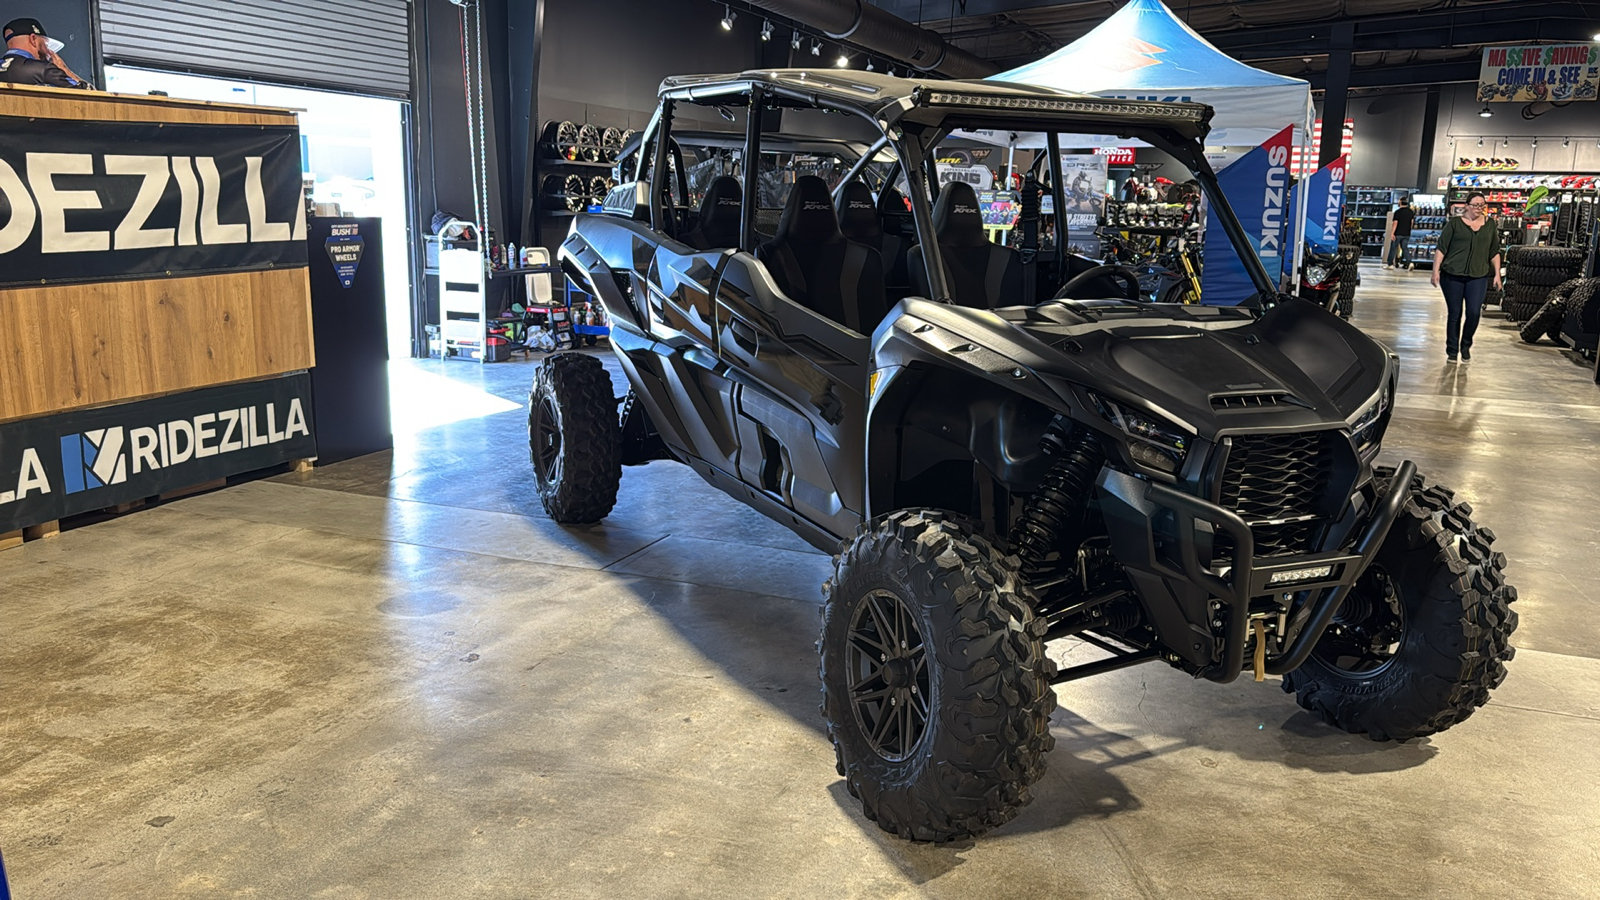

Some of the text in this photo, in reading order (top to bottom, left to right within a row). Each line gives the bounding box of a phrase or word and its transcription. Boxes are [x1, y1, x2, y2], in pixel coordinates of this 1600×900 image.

[1497, 67, 1531, 86] COME
[1532, 67, 1546, 84] IN
[1547, 69, 1557, 84] &
[1559, 66, 1581, 84] SEE
[940, 171, 981, 185] KING
[1260, 145, 1288, 258] SUZUKI
[1323, 166, 1344, 241] SUZUKI
[332, 228, 350, 236] BUSH
[342, 244, 360, 252] ARMOR
[335, 253, 357, 262] WHEELS
[130, 397, 310, 475] RIDEZILLA
